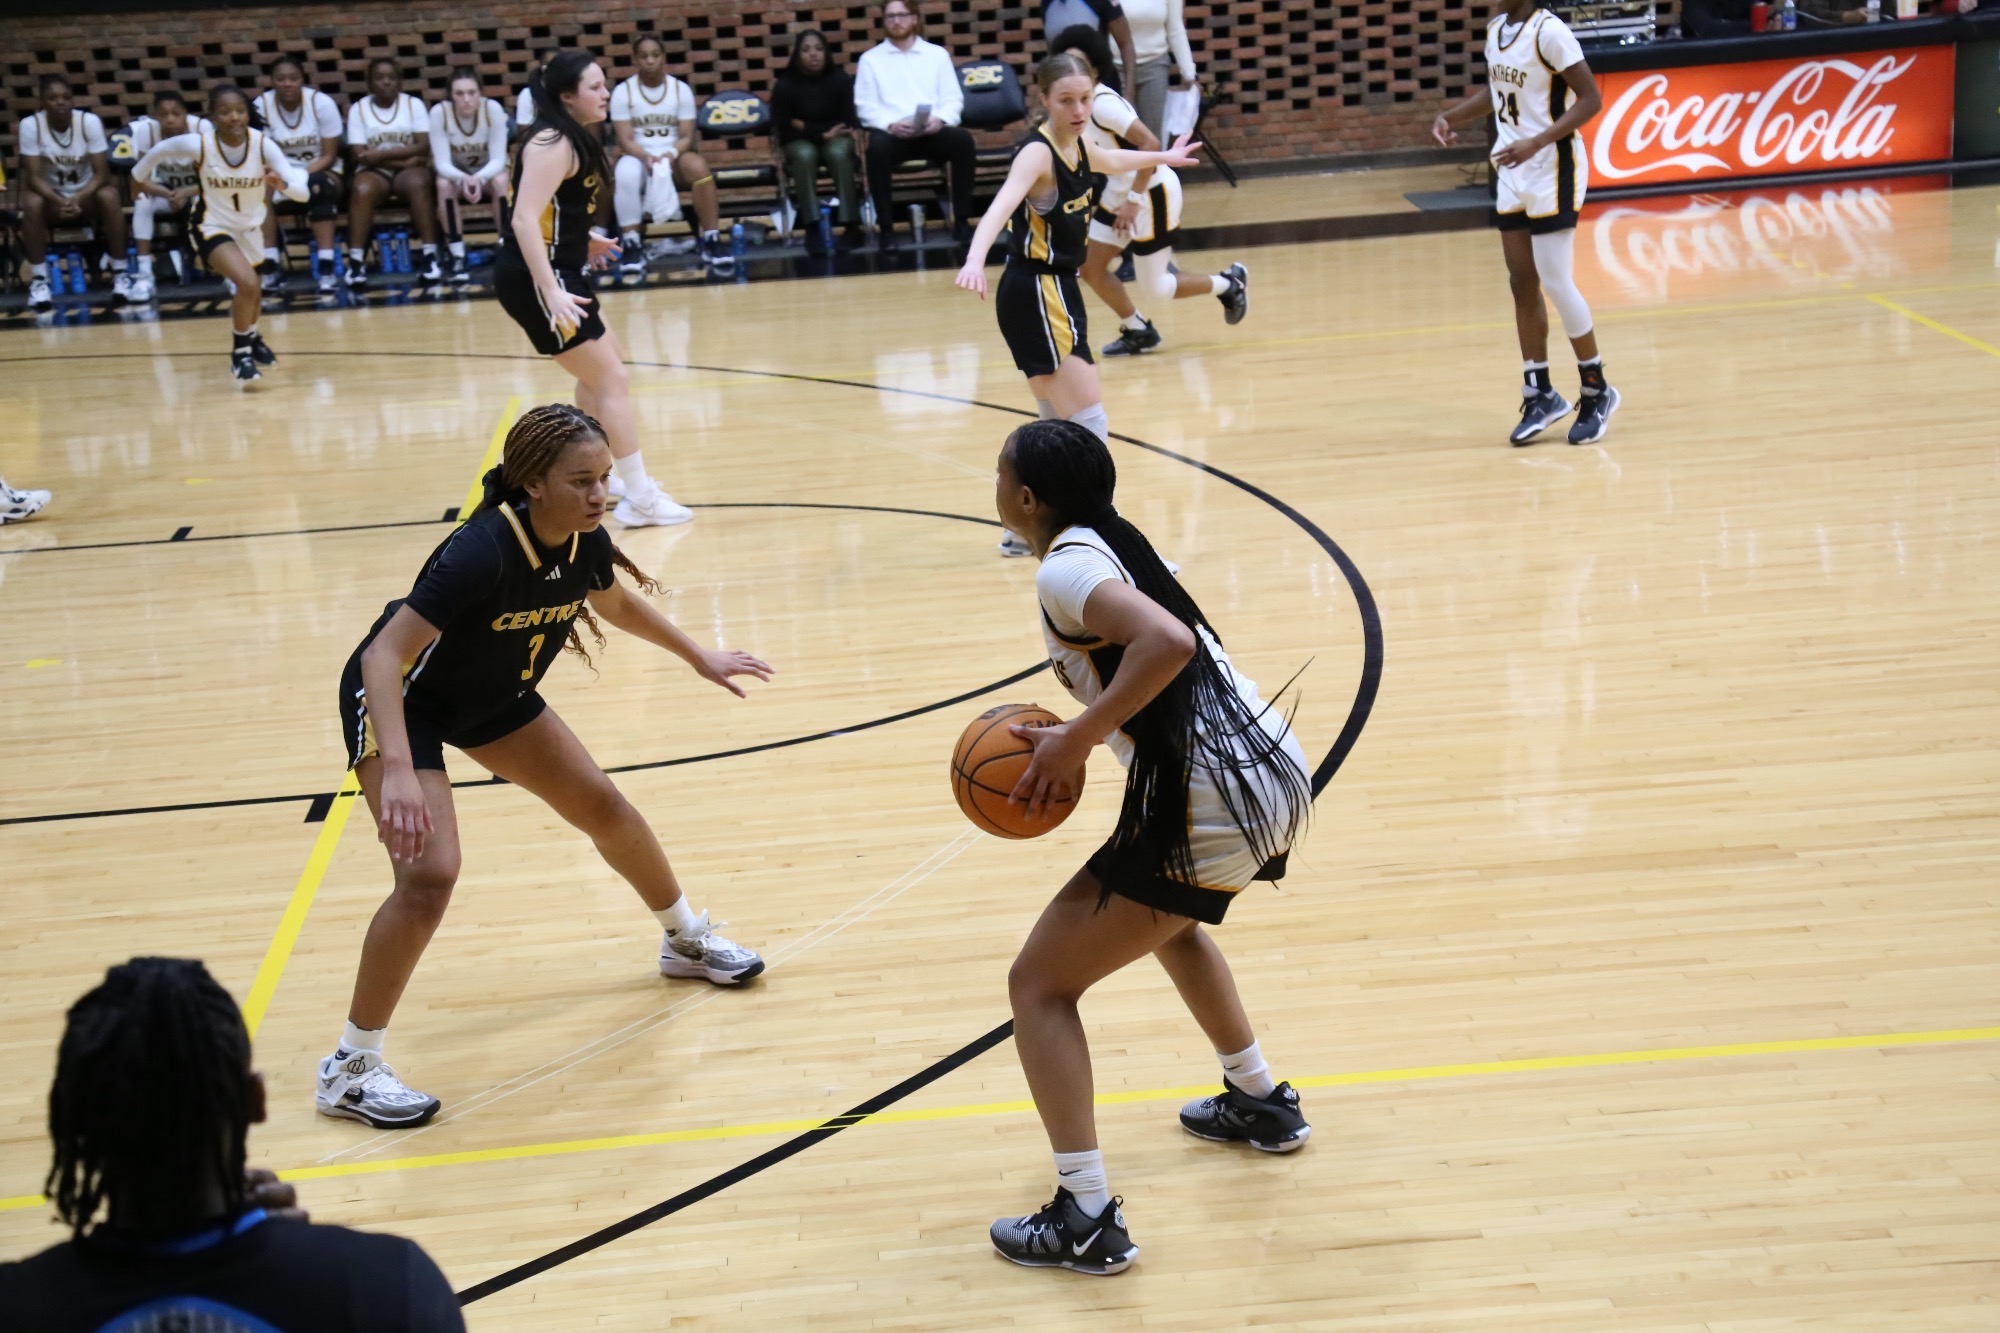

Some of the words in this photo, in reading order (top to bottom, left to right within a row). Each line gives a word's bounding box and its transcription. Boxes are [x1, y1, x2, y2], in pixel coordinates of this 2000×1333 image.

[1497, 90, 1519, 127] 24
[1592, 54, 1917, 179] Coca-Cola
[231, 193, 240, 212] 1
[491, 600, 582, 632] CENTRE
[521, 633, 545, 680] 3
